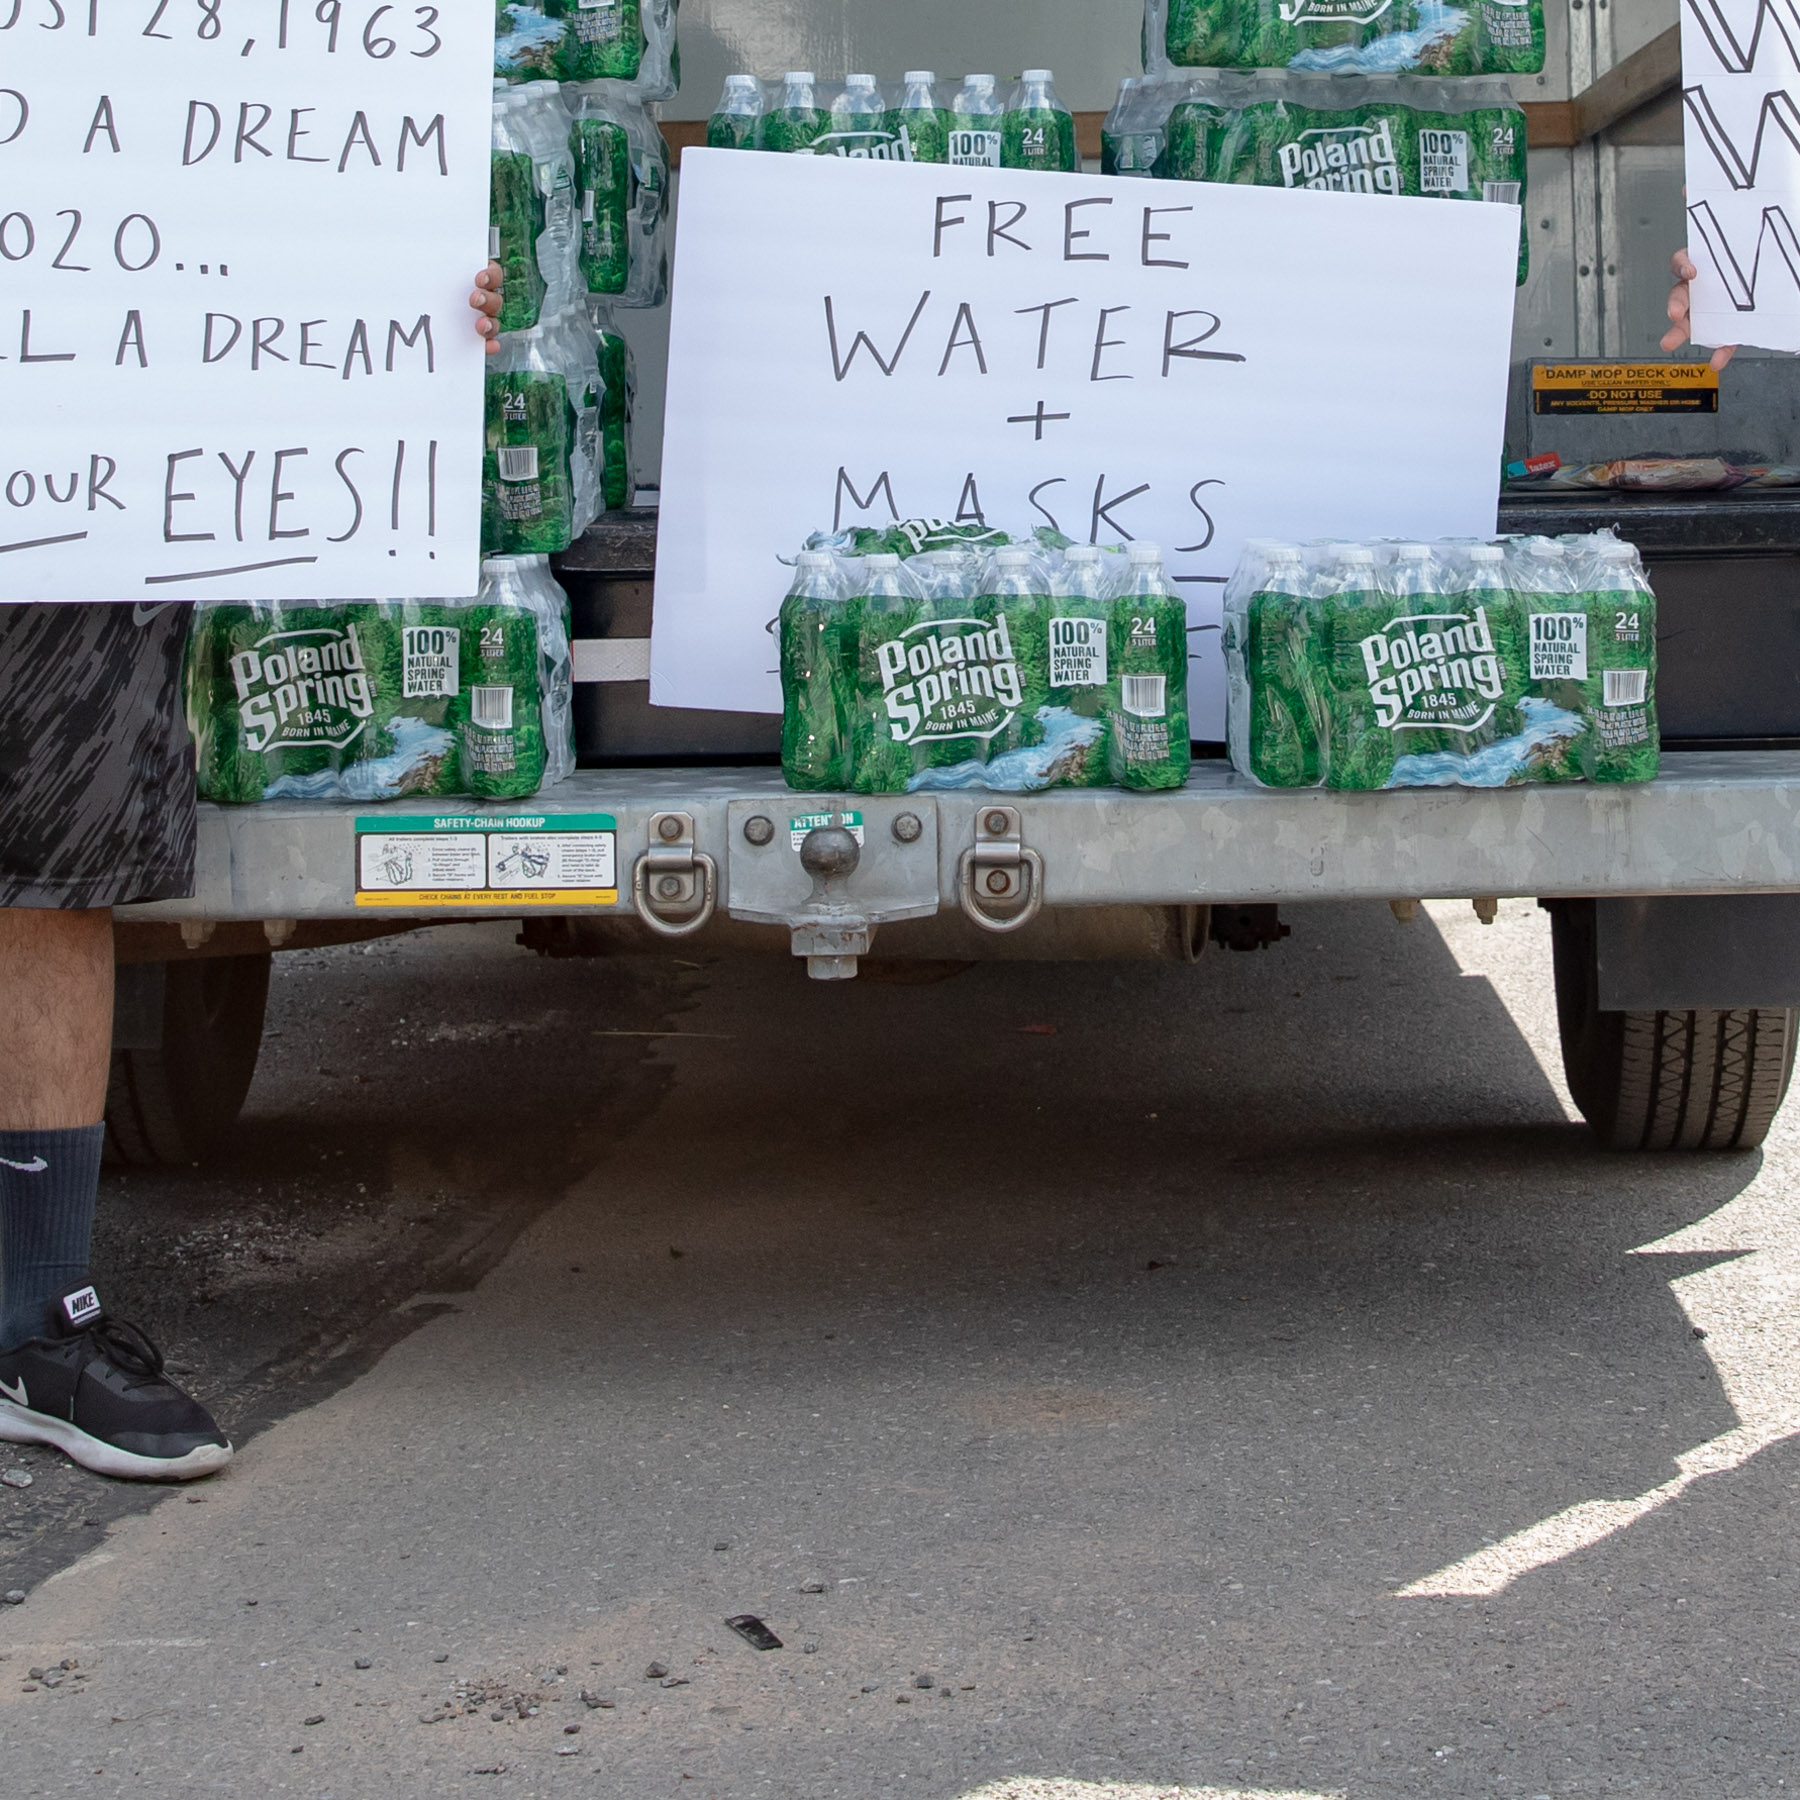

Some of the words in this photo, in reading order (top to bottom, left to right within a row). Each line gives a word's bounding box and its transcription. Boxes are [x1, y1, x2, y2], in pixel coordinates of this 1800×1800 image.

[84, 95, 120, 154] A
[182, 99, 448, 177] DREAM
[1278, 119, 1395, 187] Poland
[934, 194, 1194, 270] FREE
[116, 309, 148, 368] A
[203, 312, 433, 381] DREAM
[824, 290, 1246, 382] WATER
[1546, 369, 1586, 379] DAMP
[1591, 369, 1622, 378] MOP
[1627, 368, 1665, 378] DECK
[1670, 368, 1705, 378] ONLY
[1589, 390, 1609, 399] DO
[1611, 391, 1636, 399] NOT
[1639, 390, 1662, 399] USE
[1007, 401, 1071, 441] +
[1529, 461, 1556, 472] latex
[833, 466, 1227, 553] MASKS
[1131, 617, 1156, 635] 24
[1532, 616, 1584, 641] 100%
[1615, 611, 1640, 630] 24
[1052, 620, 1103, 646] 100%
[1359, 605, 1496, 684] Poland
[875, 613, 1015, 690] Poland
[1054, 645, 1099, 658] NATURAL
[1534, 642, 1580, 654] NATURAL
[1534, 653, 1573, 665] SPRING
[229, 622, 365, 700] Poland
[1054, 658, 1092, 670] SPRING
[1534, 664, 1570, 676] WATER
[1054, 670, 1090, 682] WATER
[883, 660, 1023, 743] Spring
[1368, 657, 1504, 728] Spring
[1421, 693, 1456, 708] 1845
[240, 674, 374, 751] Spring
[1408, 709, 1435, 719] BORN
[1438, 710, 1450, 719] IN
[1453, 700, 1480, 719] MAINE
[434, 818, 504, 828] SAFETY-CHAIN
[506, 817, 545, 828] HOOKUP
[72, 1292, 94, 1315] NIKE
